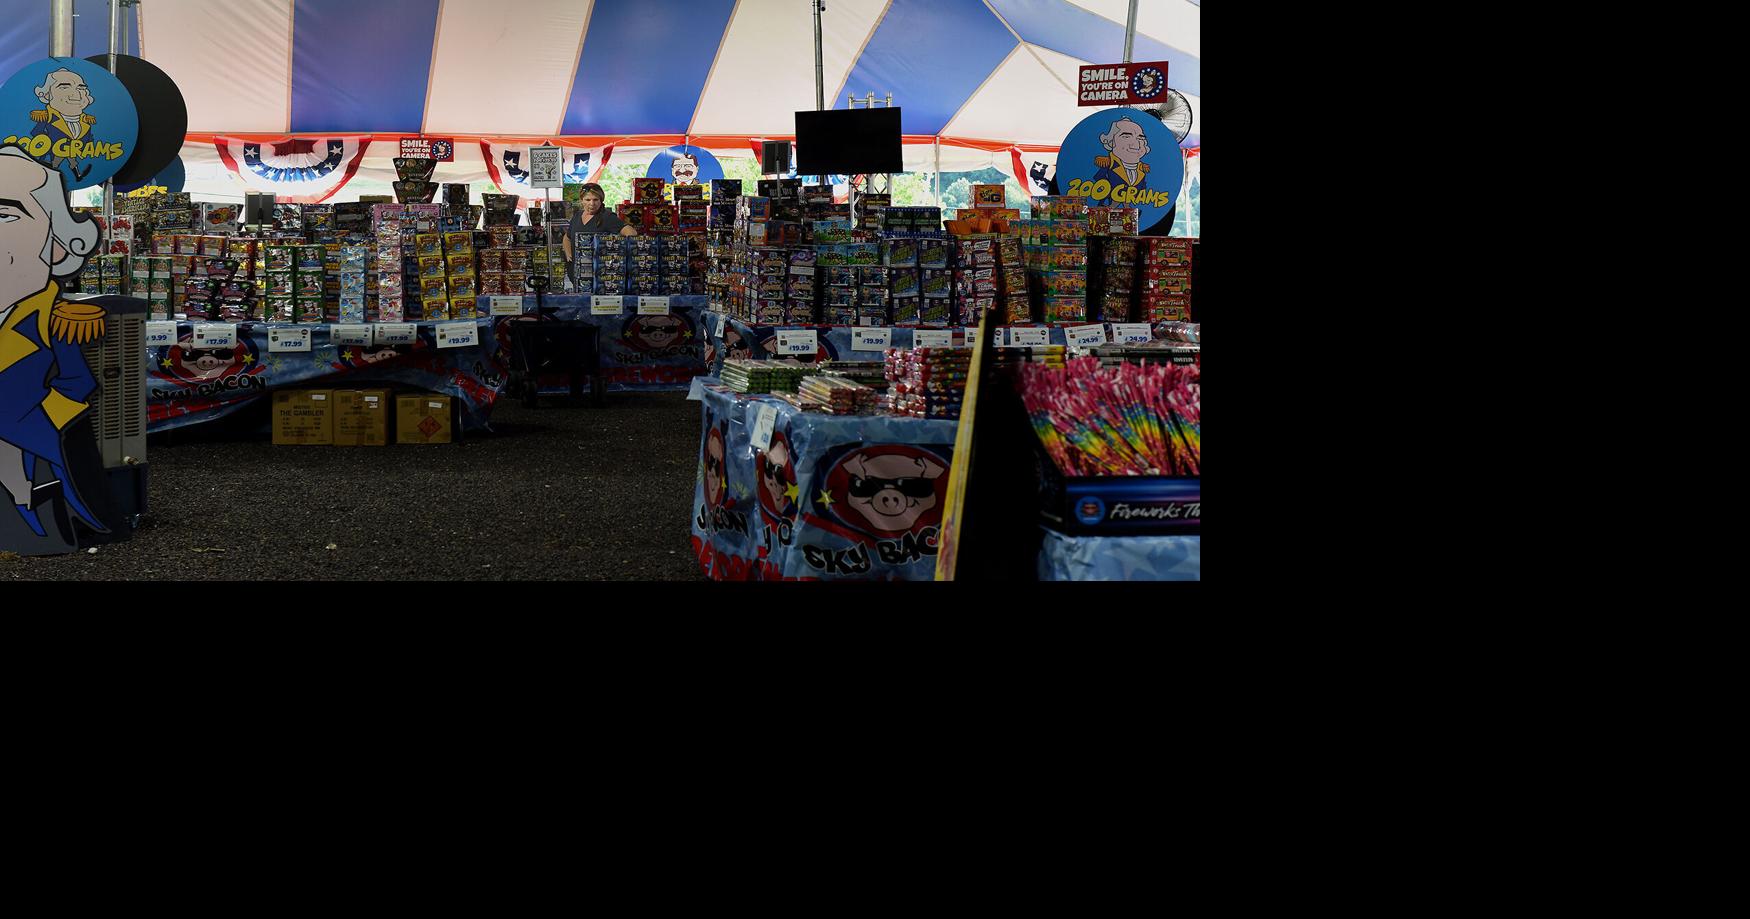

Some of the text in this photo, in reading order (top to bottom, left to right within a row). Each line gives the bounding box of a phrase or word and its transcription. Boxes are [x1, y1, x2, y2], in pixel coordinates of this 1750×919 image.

[1081, 68, 1130, 82] SMILE,
[1080, 90, 1128, 101] CAMERA
[1081, 81, 1129, 92] YOU'RE ON
[51, 137, 124, 161] GRAMS
[401, 139, 431, 148] SMILE,
[1067, 178, 1169, 208] 200 GRAMS
[197, 374, 267, 397] BACON
[1110, 502, 1181, 520] Fireworks
[803, 541, 872, 576] SKY
